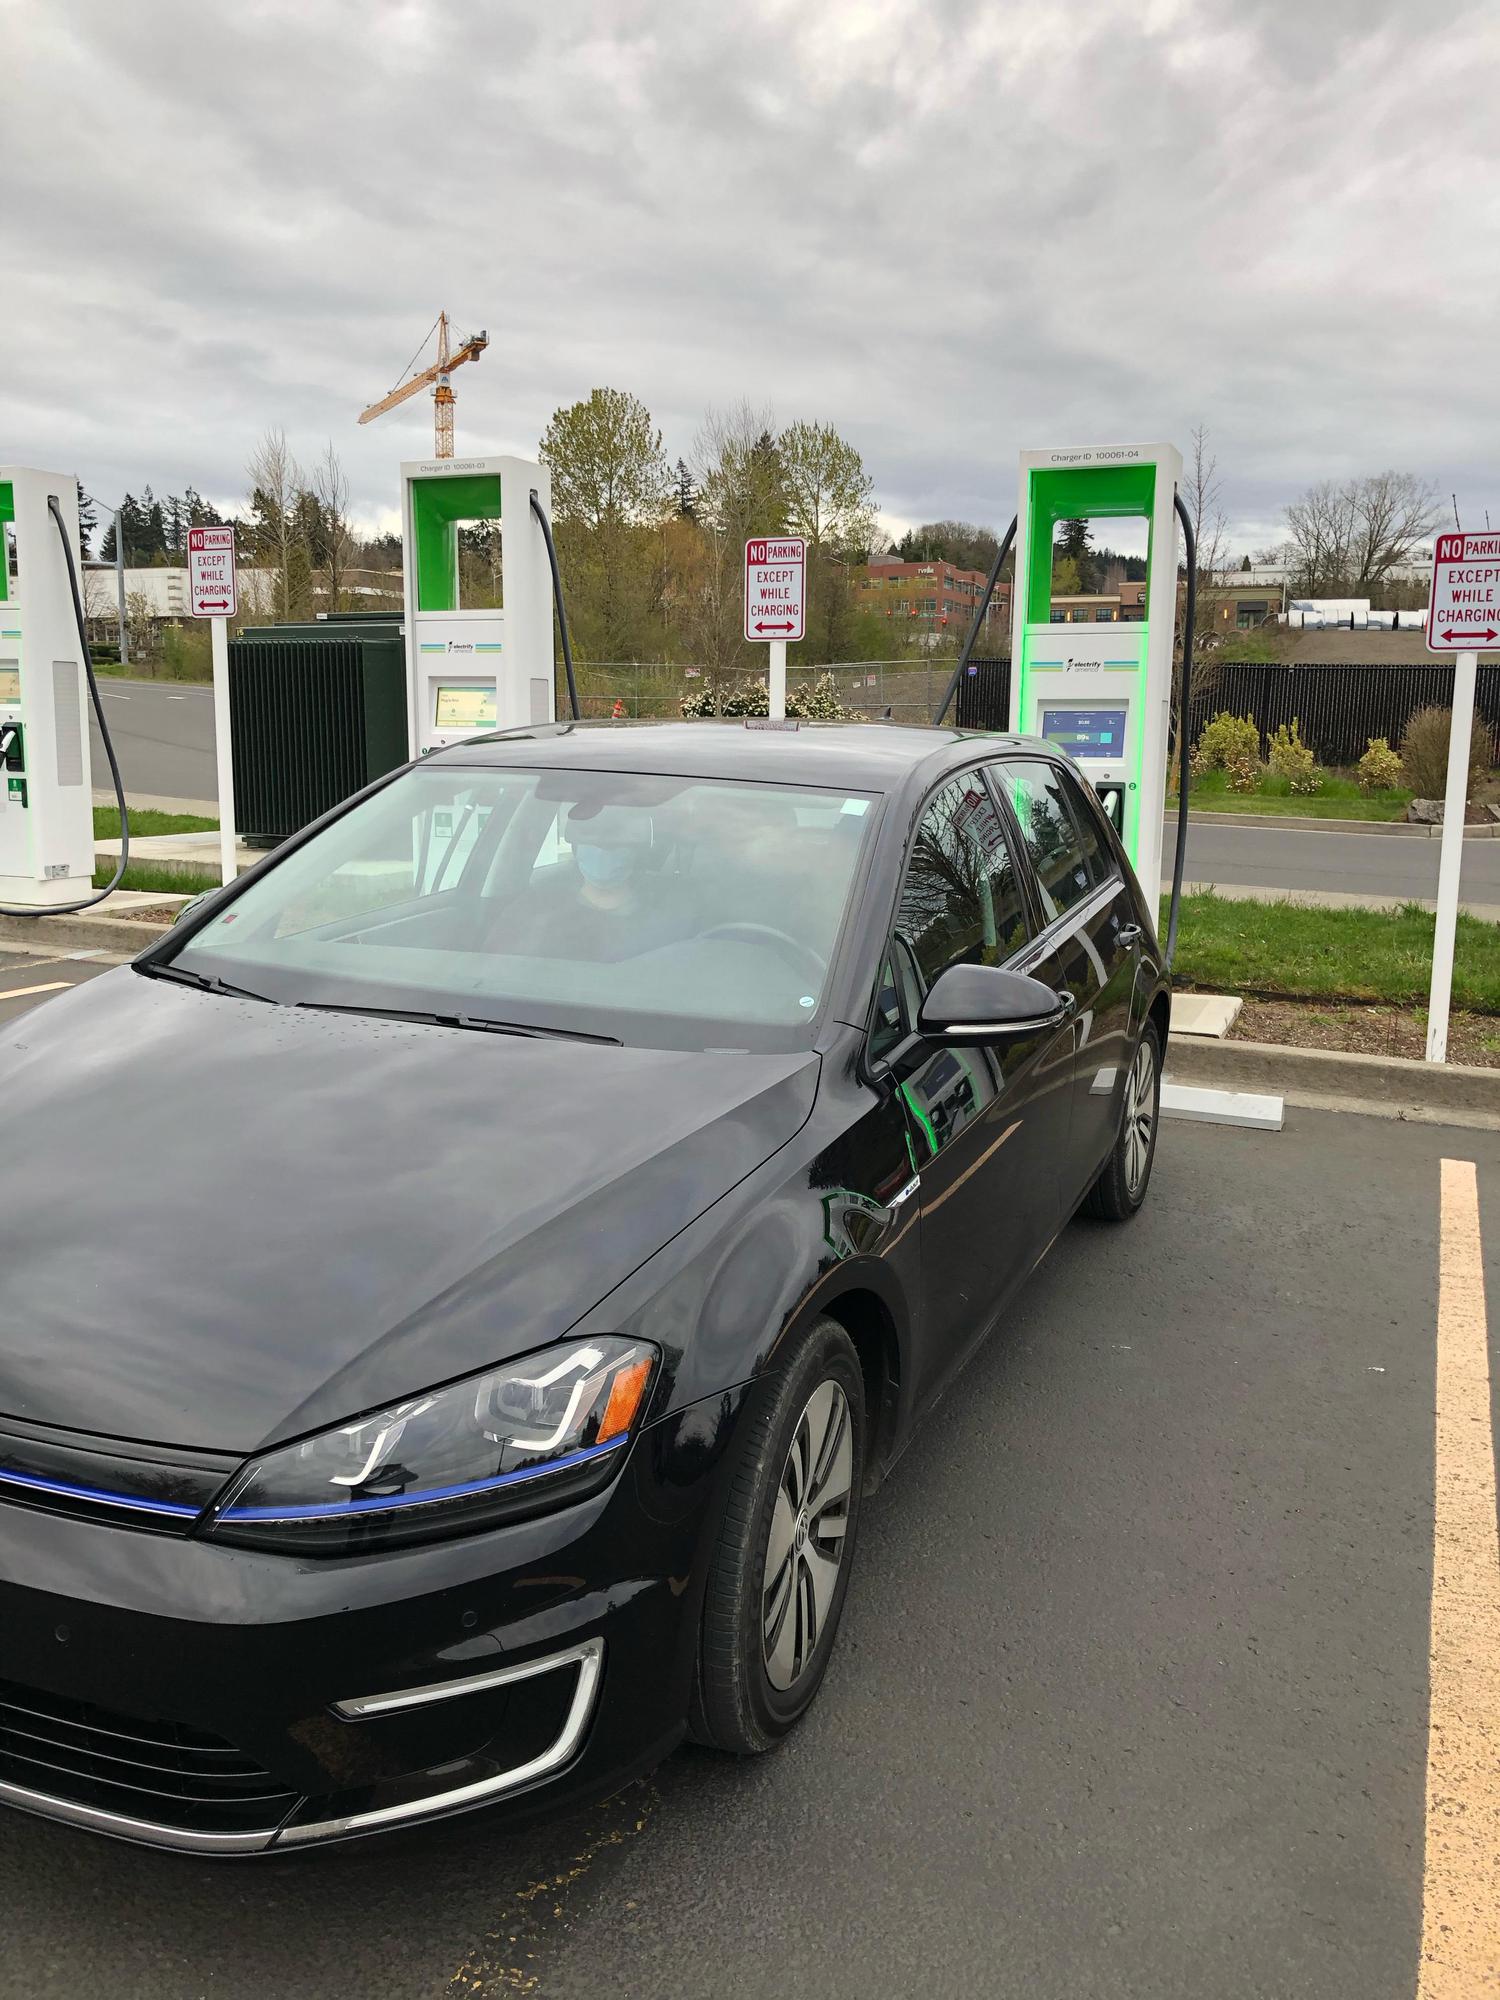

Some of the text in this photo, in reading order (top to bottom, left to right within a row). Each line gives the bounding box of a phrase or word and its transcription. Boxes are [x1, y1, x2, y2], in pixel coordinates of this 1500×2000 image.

[1051, 450, 1082, 463] Charger
[1096, 450, 1139, 460] 100061-04
[191, 533, 231, 548] NO PARKING
[750, 544, 801, 562] NO PARKING
[1440, 539, 1500, 559] NO PARKI
[197, 555, 226, 567] EXCEPT
[200, 570, 224, 581] WHILE
[756, 570, 794, 583] EXCEPT
[1448, 569, 1500, 584] EXCEPT
[194, 584, 232, 596] CHARGING
[760, 587, 790, 600] WHILE
[1451, 588, 1494, 603] WHILE
[750, 604, 799, 617] CHARGING
[1074, 660, 1102, 669] electrify
